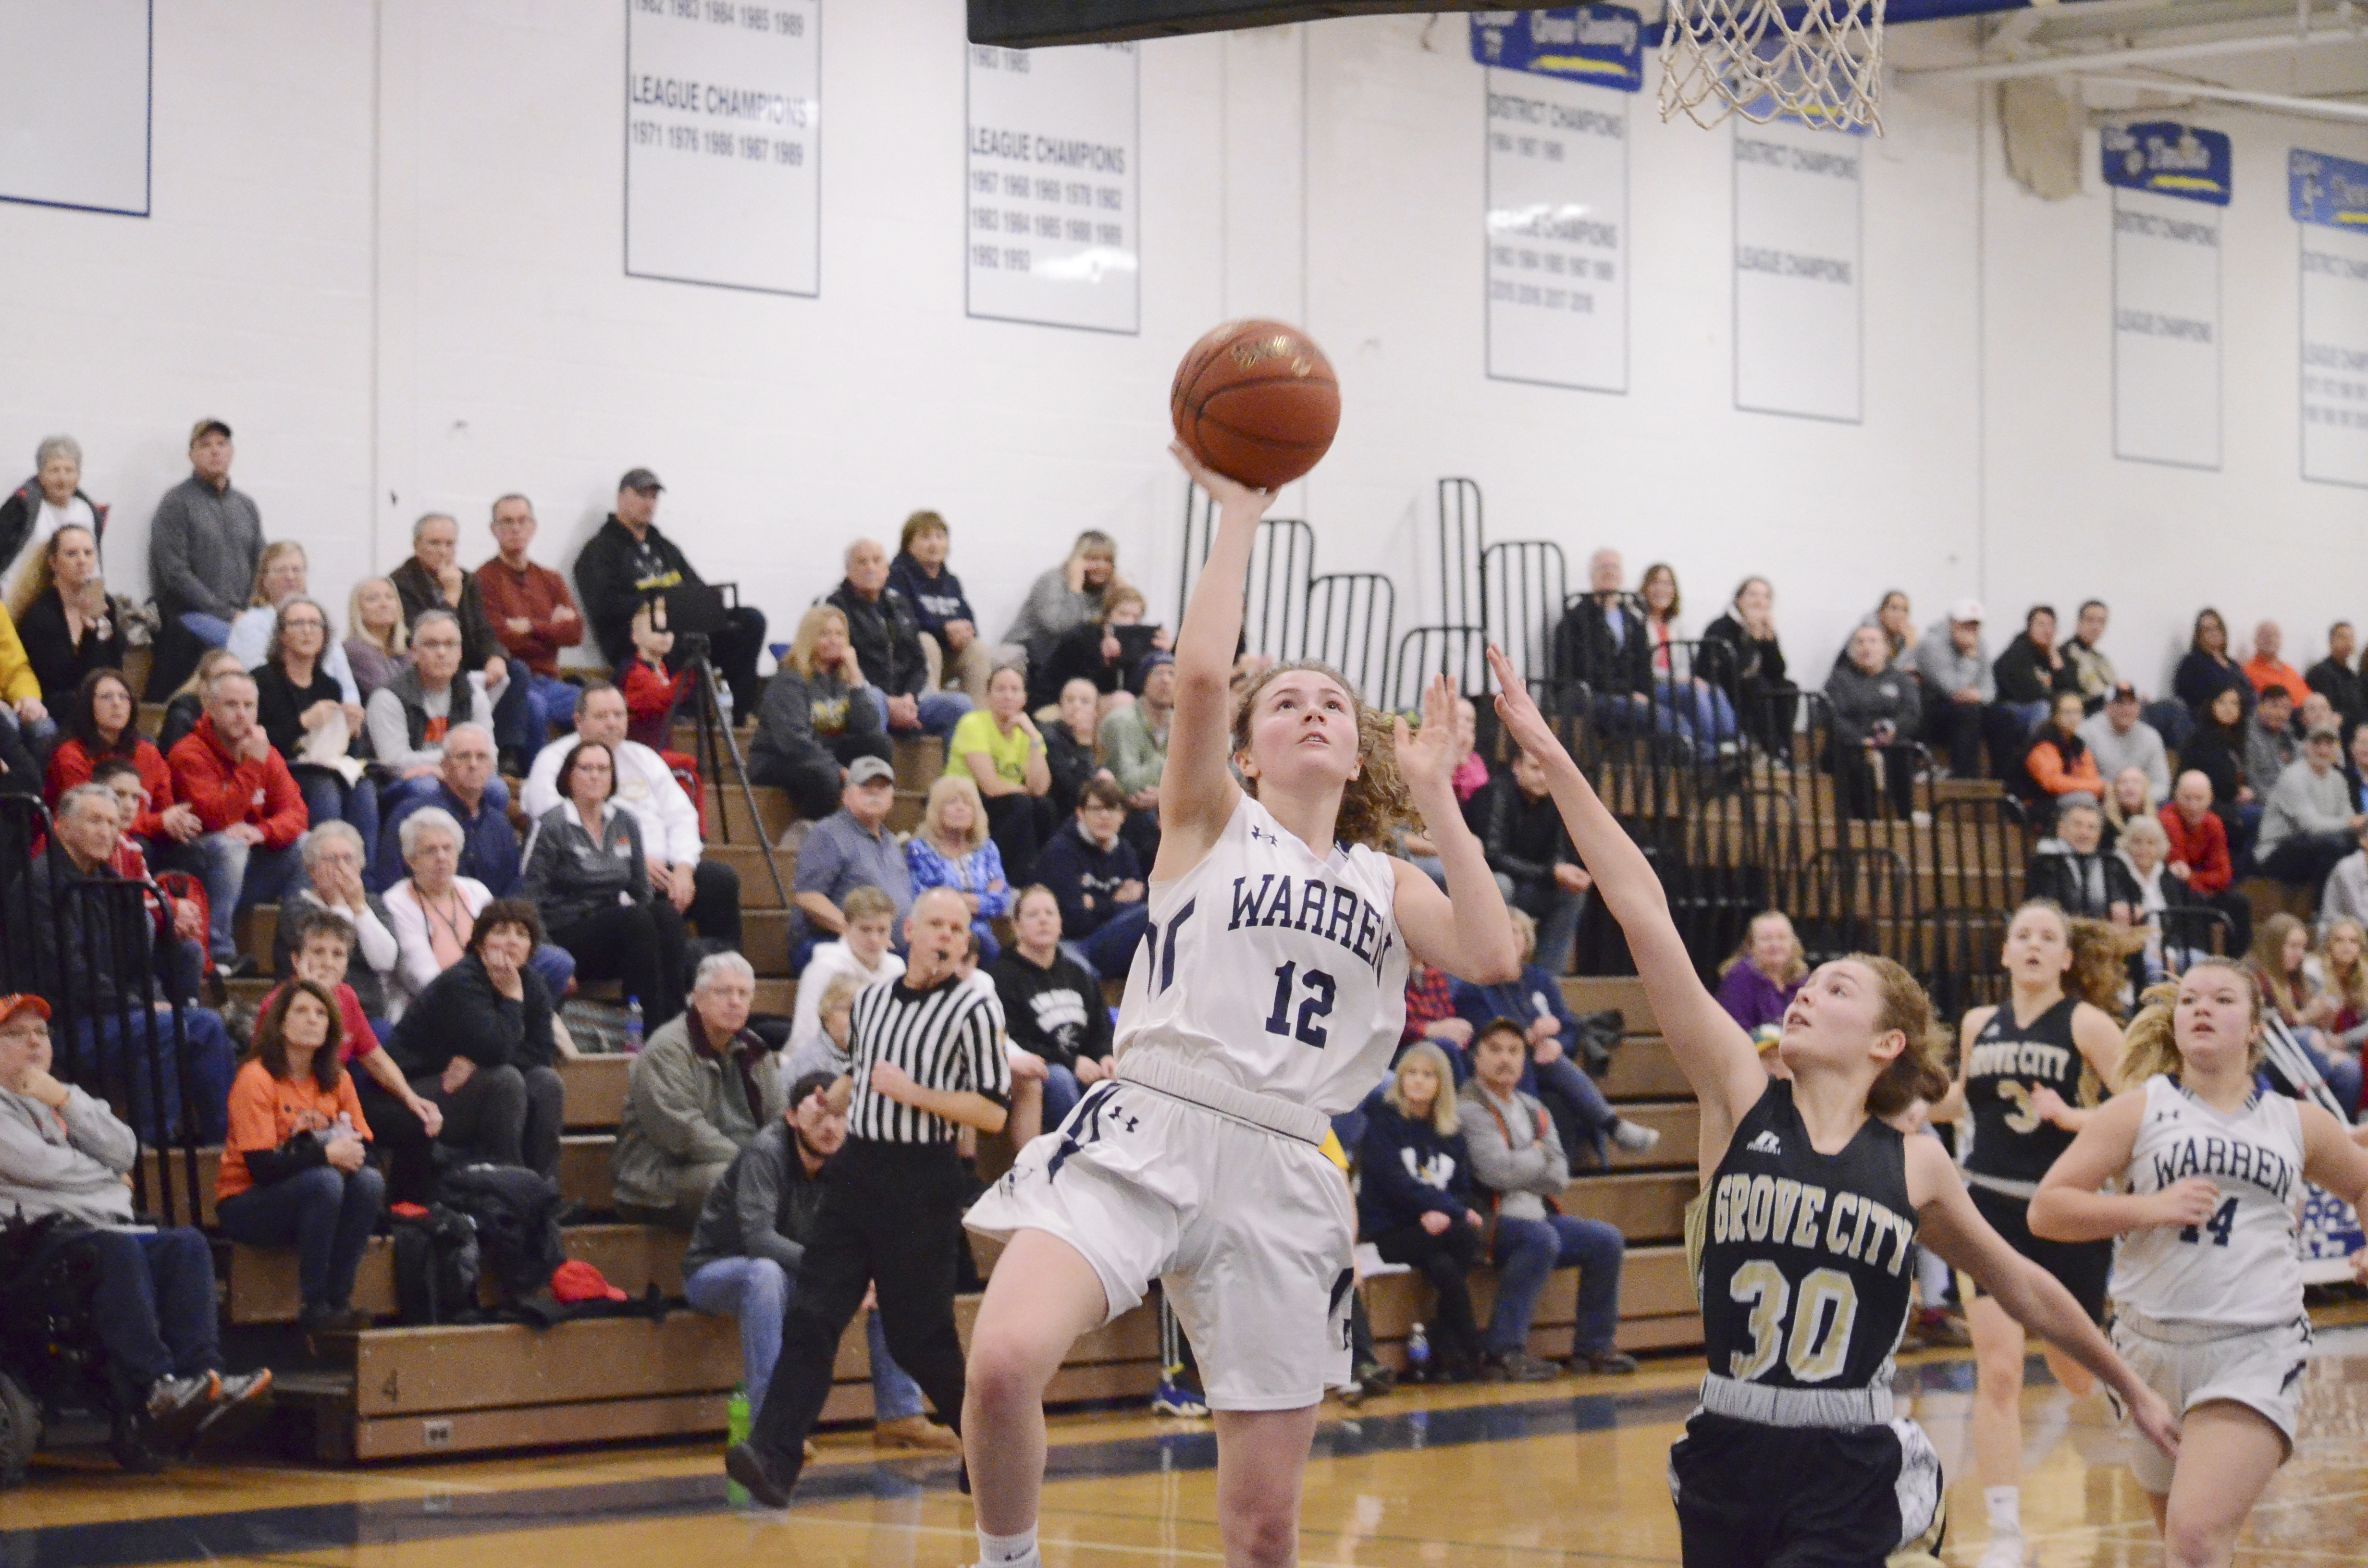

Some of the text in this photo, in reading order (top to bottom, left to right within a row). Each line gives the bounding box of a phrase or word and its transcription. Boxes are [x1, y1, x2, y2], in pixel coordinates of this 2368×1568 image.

[632, 74, 807, 129] LEAGUE CHAMPIONS
[1550, 102, 1623, 140] CHAMPIONS
[971, 126, 1125, 174] LEAGUE CHAMPIONS
[1265, 960, 1336, 1049] 12
[2154, 1136, 2294, 1203] WARREN
[1714, 1172, 1912, 1277] GROVE CITY
[1730, 1259, 1858, 1383] 30
